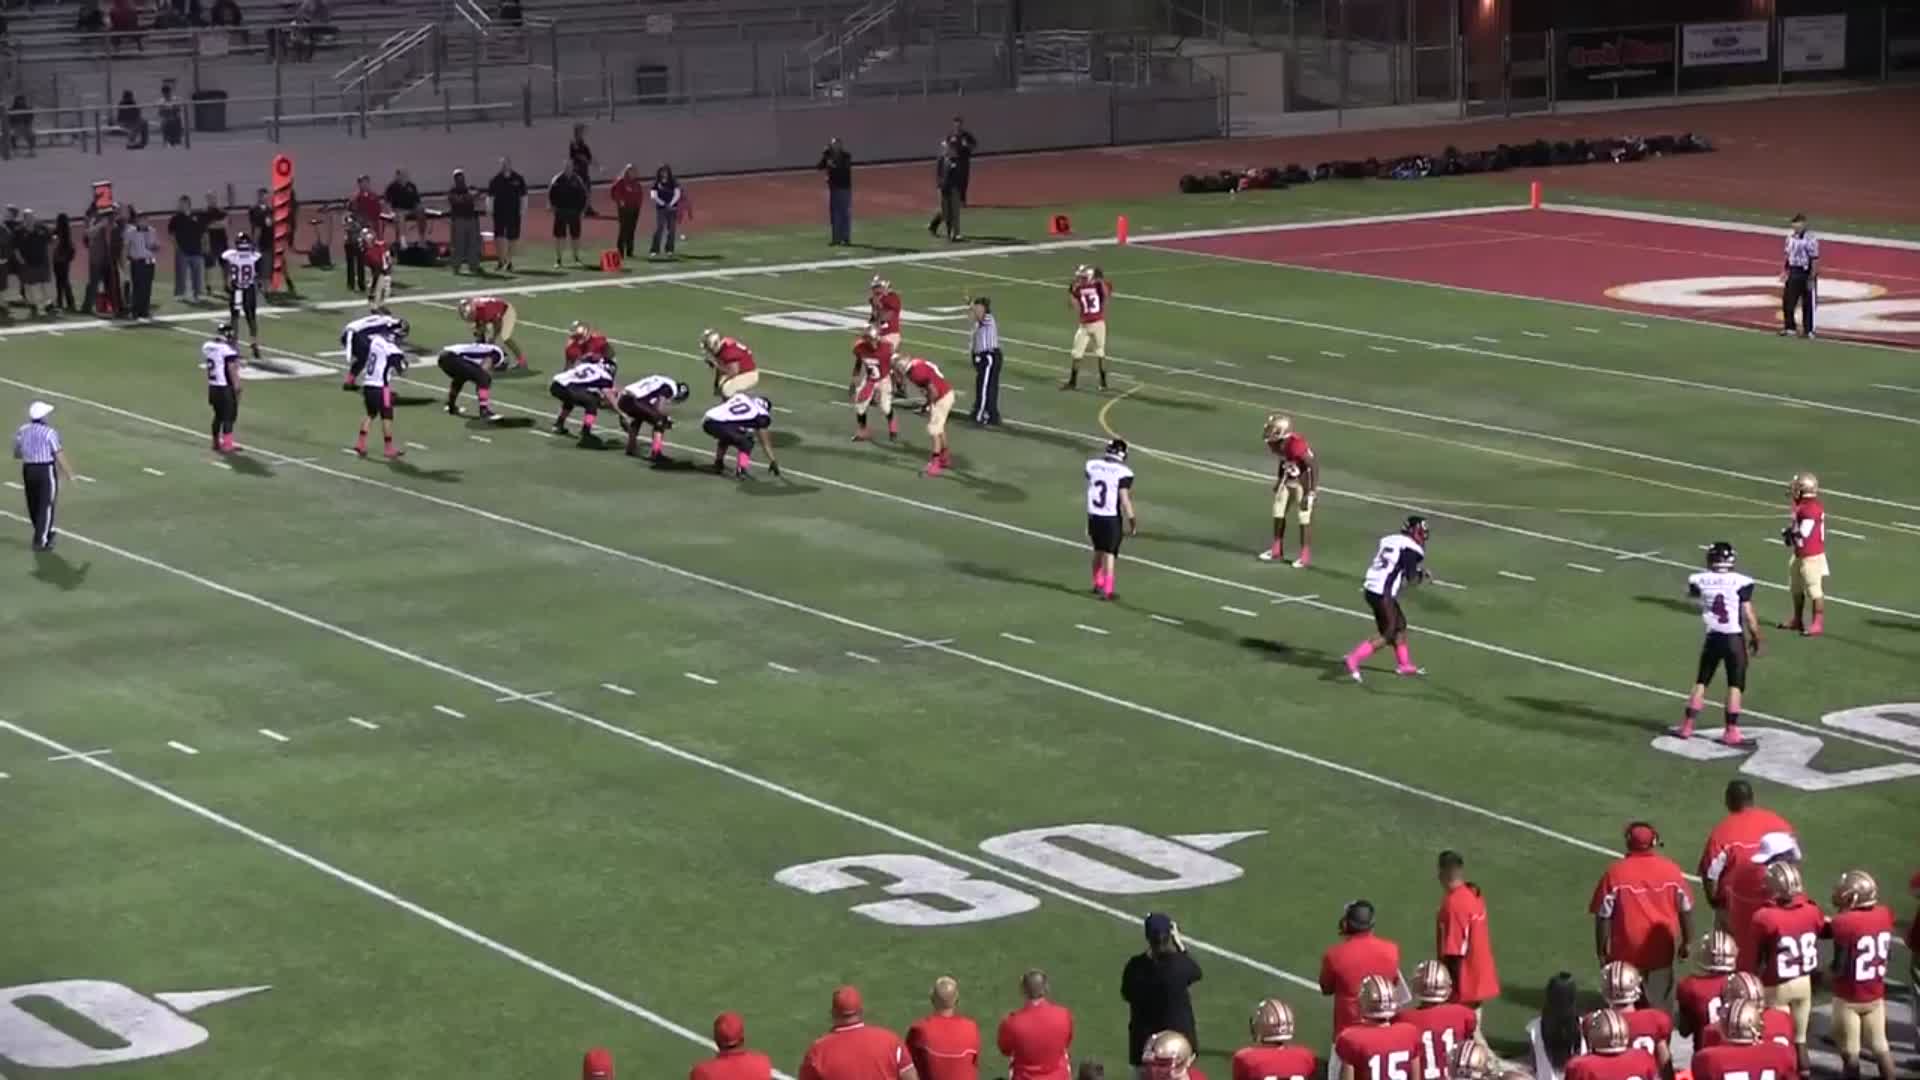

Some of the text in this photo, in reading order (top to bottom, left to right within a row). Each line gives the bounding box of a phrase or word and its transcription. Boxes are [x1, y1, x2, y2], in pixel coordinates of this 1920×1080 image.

[1080, 292, 1100, 314] 13
[1092, 479, 1108, 509] 3
[1711, 593, 1730, 625] 4
[773, 823, 1245, 926] 30
[1776, 931, 1818, 979] 28
[1855, 931, 1891, 982] 29
[1367, 1050, 1410, 1080] 15
[1421, 1028, 1458, 1080] 11
